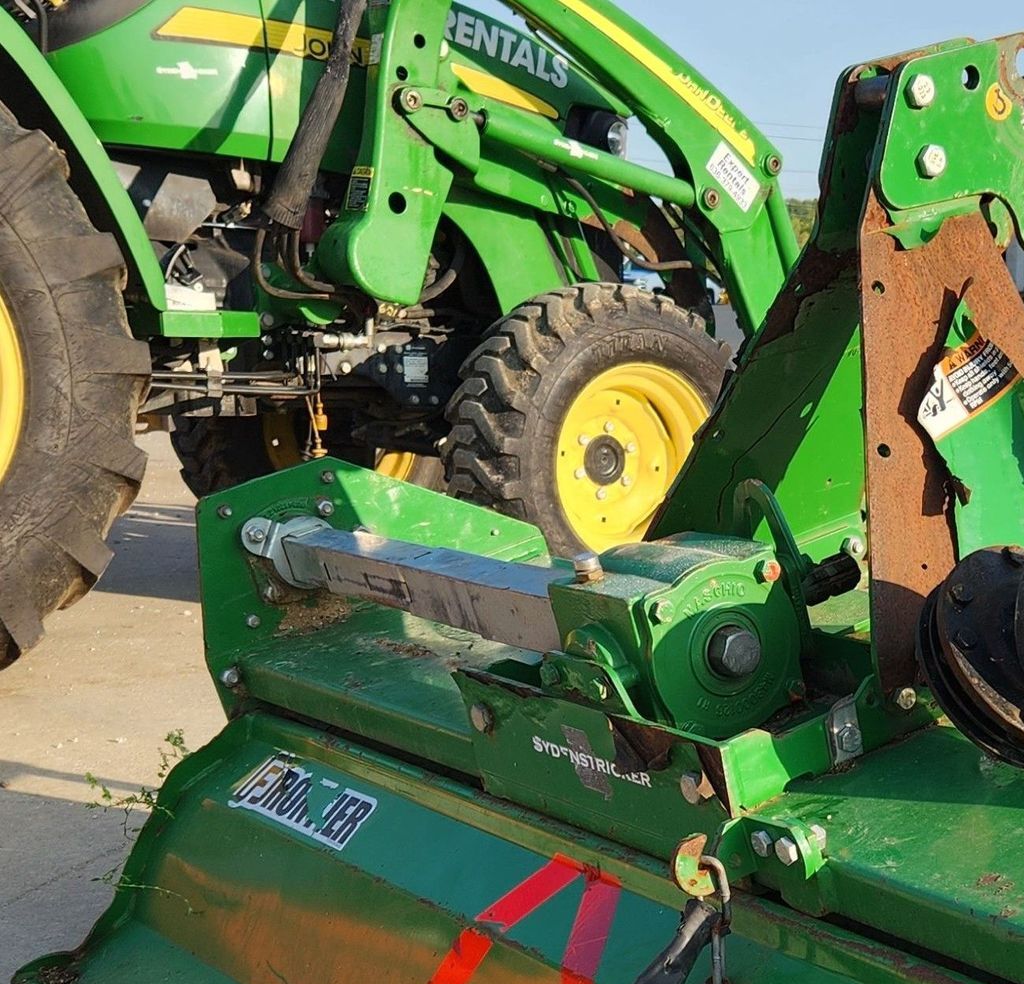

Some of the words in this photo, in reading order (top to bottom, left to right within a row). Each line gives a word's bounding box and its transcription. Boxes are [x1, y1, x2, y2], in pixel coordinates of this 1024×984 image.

[445, 11, 568, 88] RENTALS
[234, 752, 374, 845] FRONIER
[532, 735, 652, 788] SYDENSTRICER
